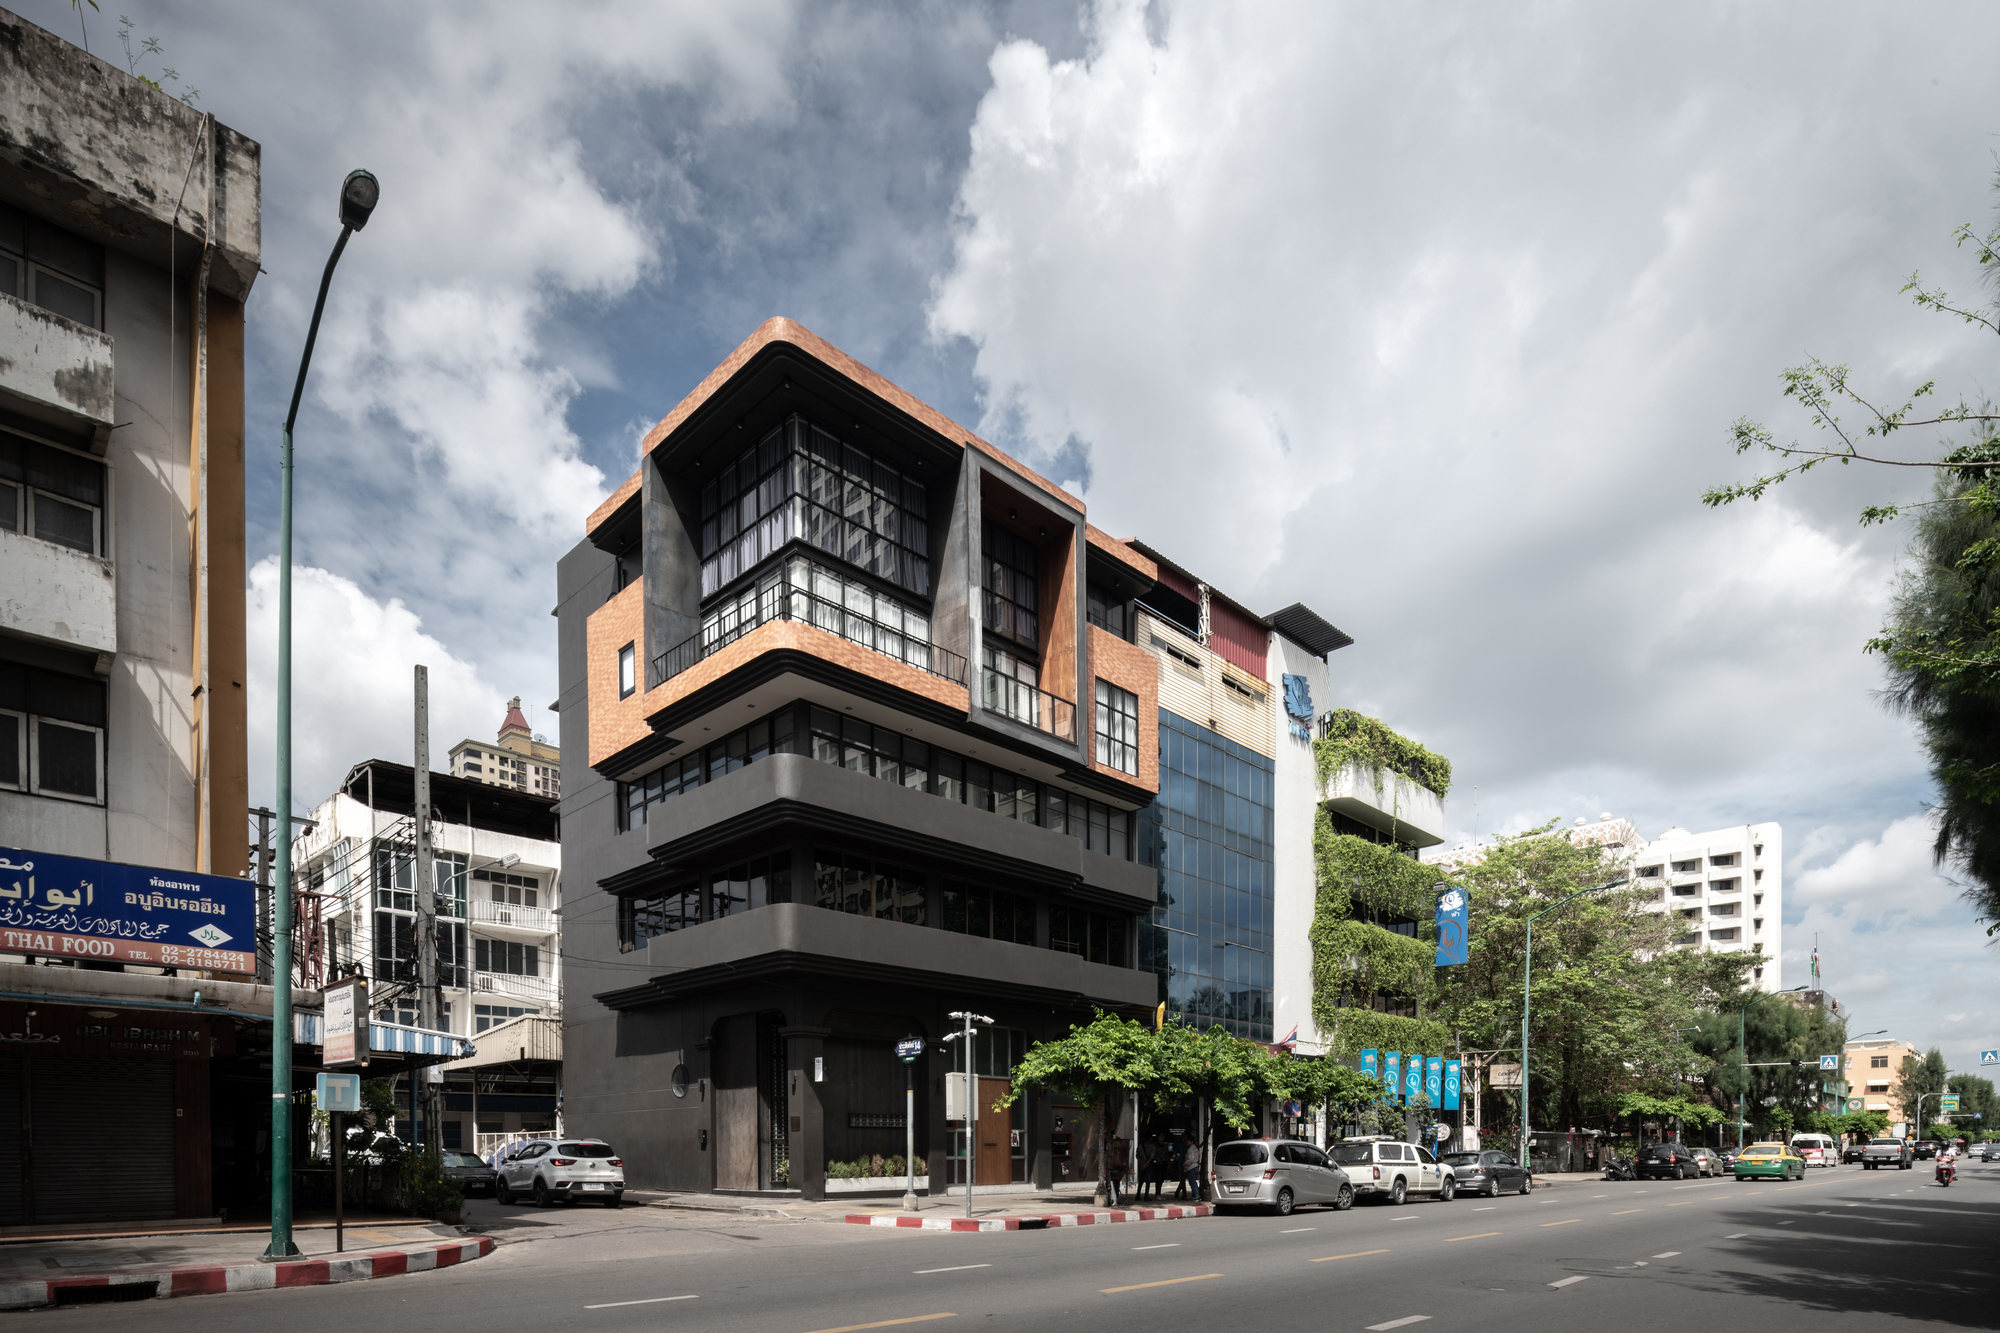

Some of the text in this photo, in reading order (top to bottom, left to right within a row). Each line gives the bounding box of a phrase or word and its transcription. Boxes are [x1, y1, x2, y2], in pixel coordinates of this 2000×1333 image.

[149, 876, 201, 892] ห้องอาหาร
[4, 930, 115, 956] THAI FOOD
[200, 929, 221, 941] حلال
[128, 945, 245, 962] TEL. 02-2784424
[161, 954, 246, 971] 02-6185711
[76, 1024, 200, 1042] ABU IBRAHIM
[110, 1041, 171, 1052] RESTAURANT
